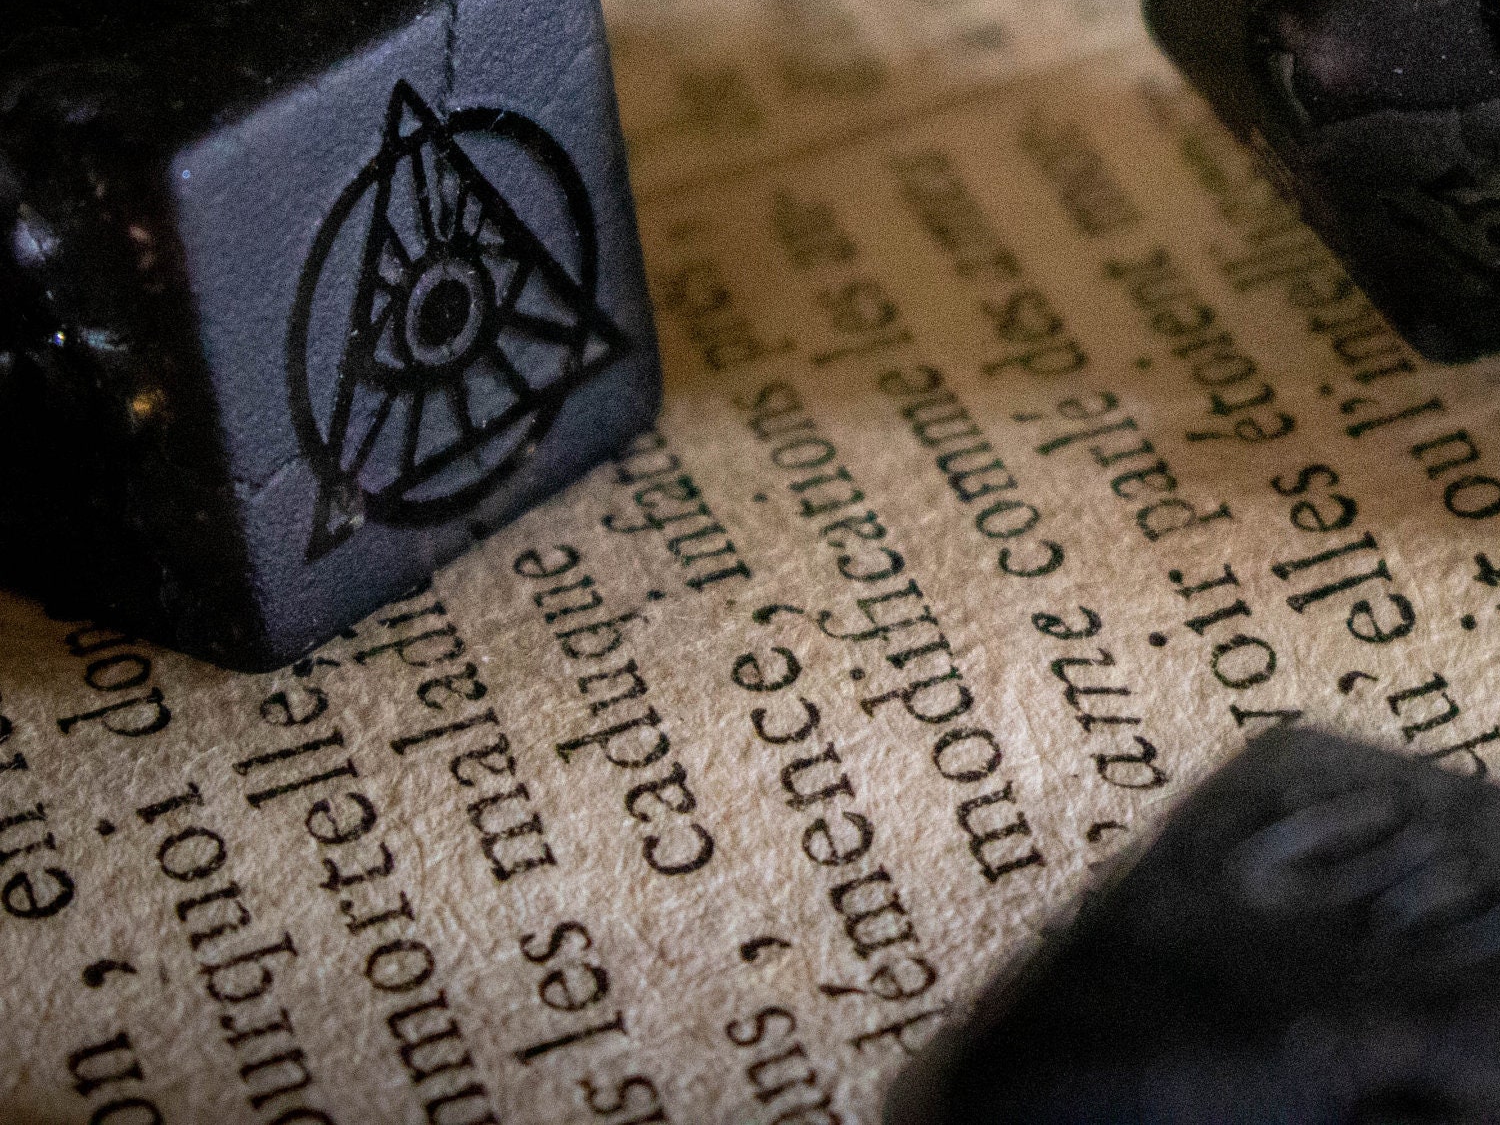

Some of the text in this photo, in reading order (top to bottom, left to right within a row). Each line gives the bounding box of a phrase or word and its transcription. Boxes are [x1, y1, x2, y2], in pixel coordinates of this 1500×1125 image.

[873, 359, 1065, 578] comme
[1012, 371, 1235, 543] parlé
[339, 585, 557, 883] maladi
[510, 542, 716, 877] caduque
[732, 372, 1044, 885] modifications
[1031, 606, 1171, 847] 'ame
[509, 921, 626, 1067] les
